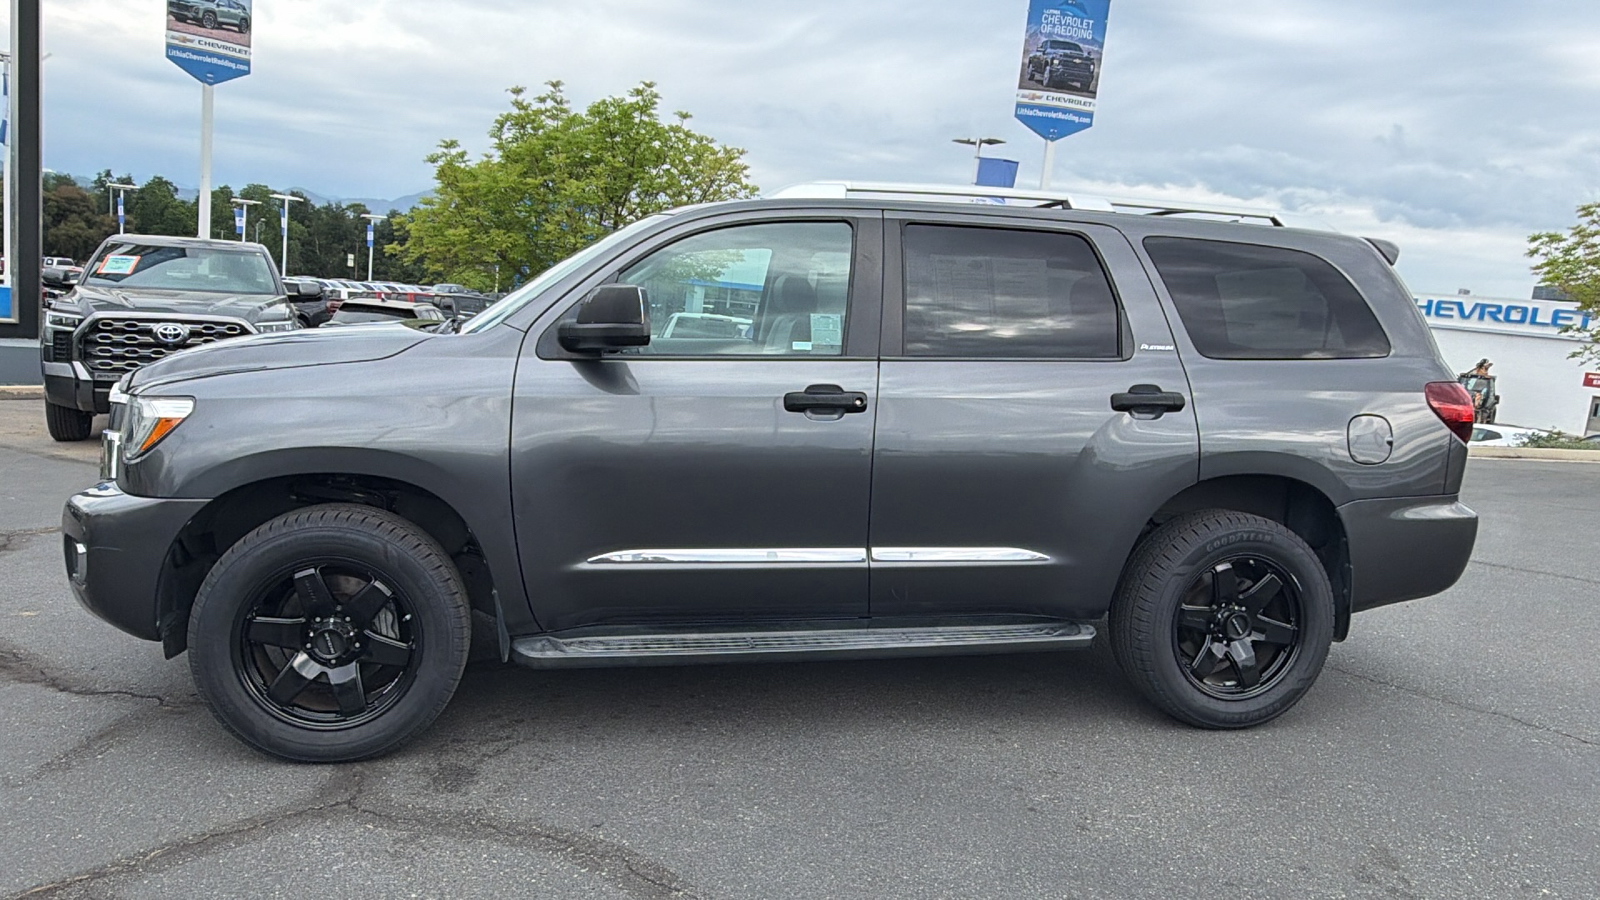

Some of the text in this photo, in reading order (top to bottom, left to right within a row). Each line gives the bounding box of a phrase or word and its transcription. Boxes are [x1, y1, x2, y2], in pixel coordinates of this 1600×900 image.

[1041, 13, 1094, 29] CHEVROLET
[1040, 23, 1093, 40] OF REDDING
[197, 39, 249, 56] CHEVROLET
[168, 48, 249, 71] LithiaChevroletRedding.com
[1045, 95, 1093, 108] CHEVROLET
[1017, 107, 1091, 124] LithiaChevroletRedding.com
[1413, 298, 1594, 329] HEVROLET
[1206, 531, 1272, 552] GOODYEAR
